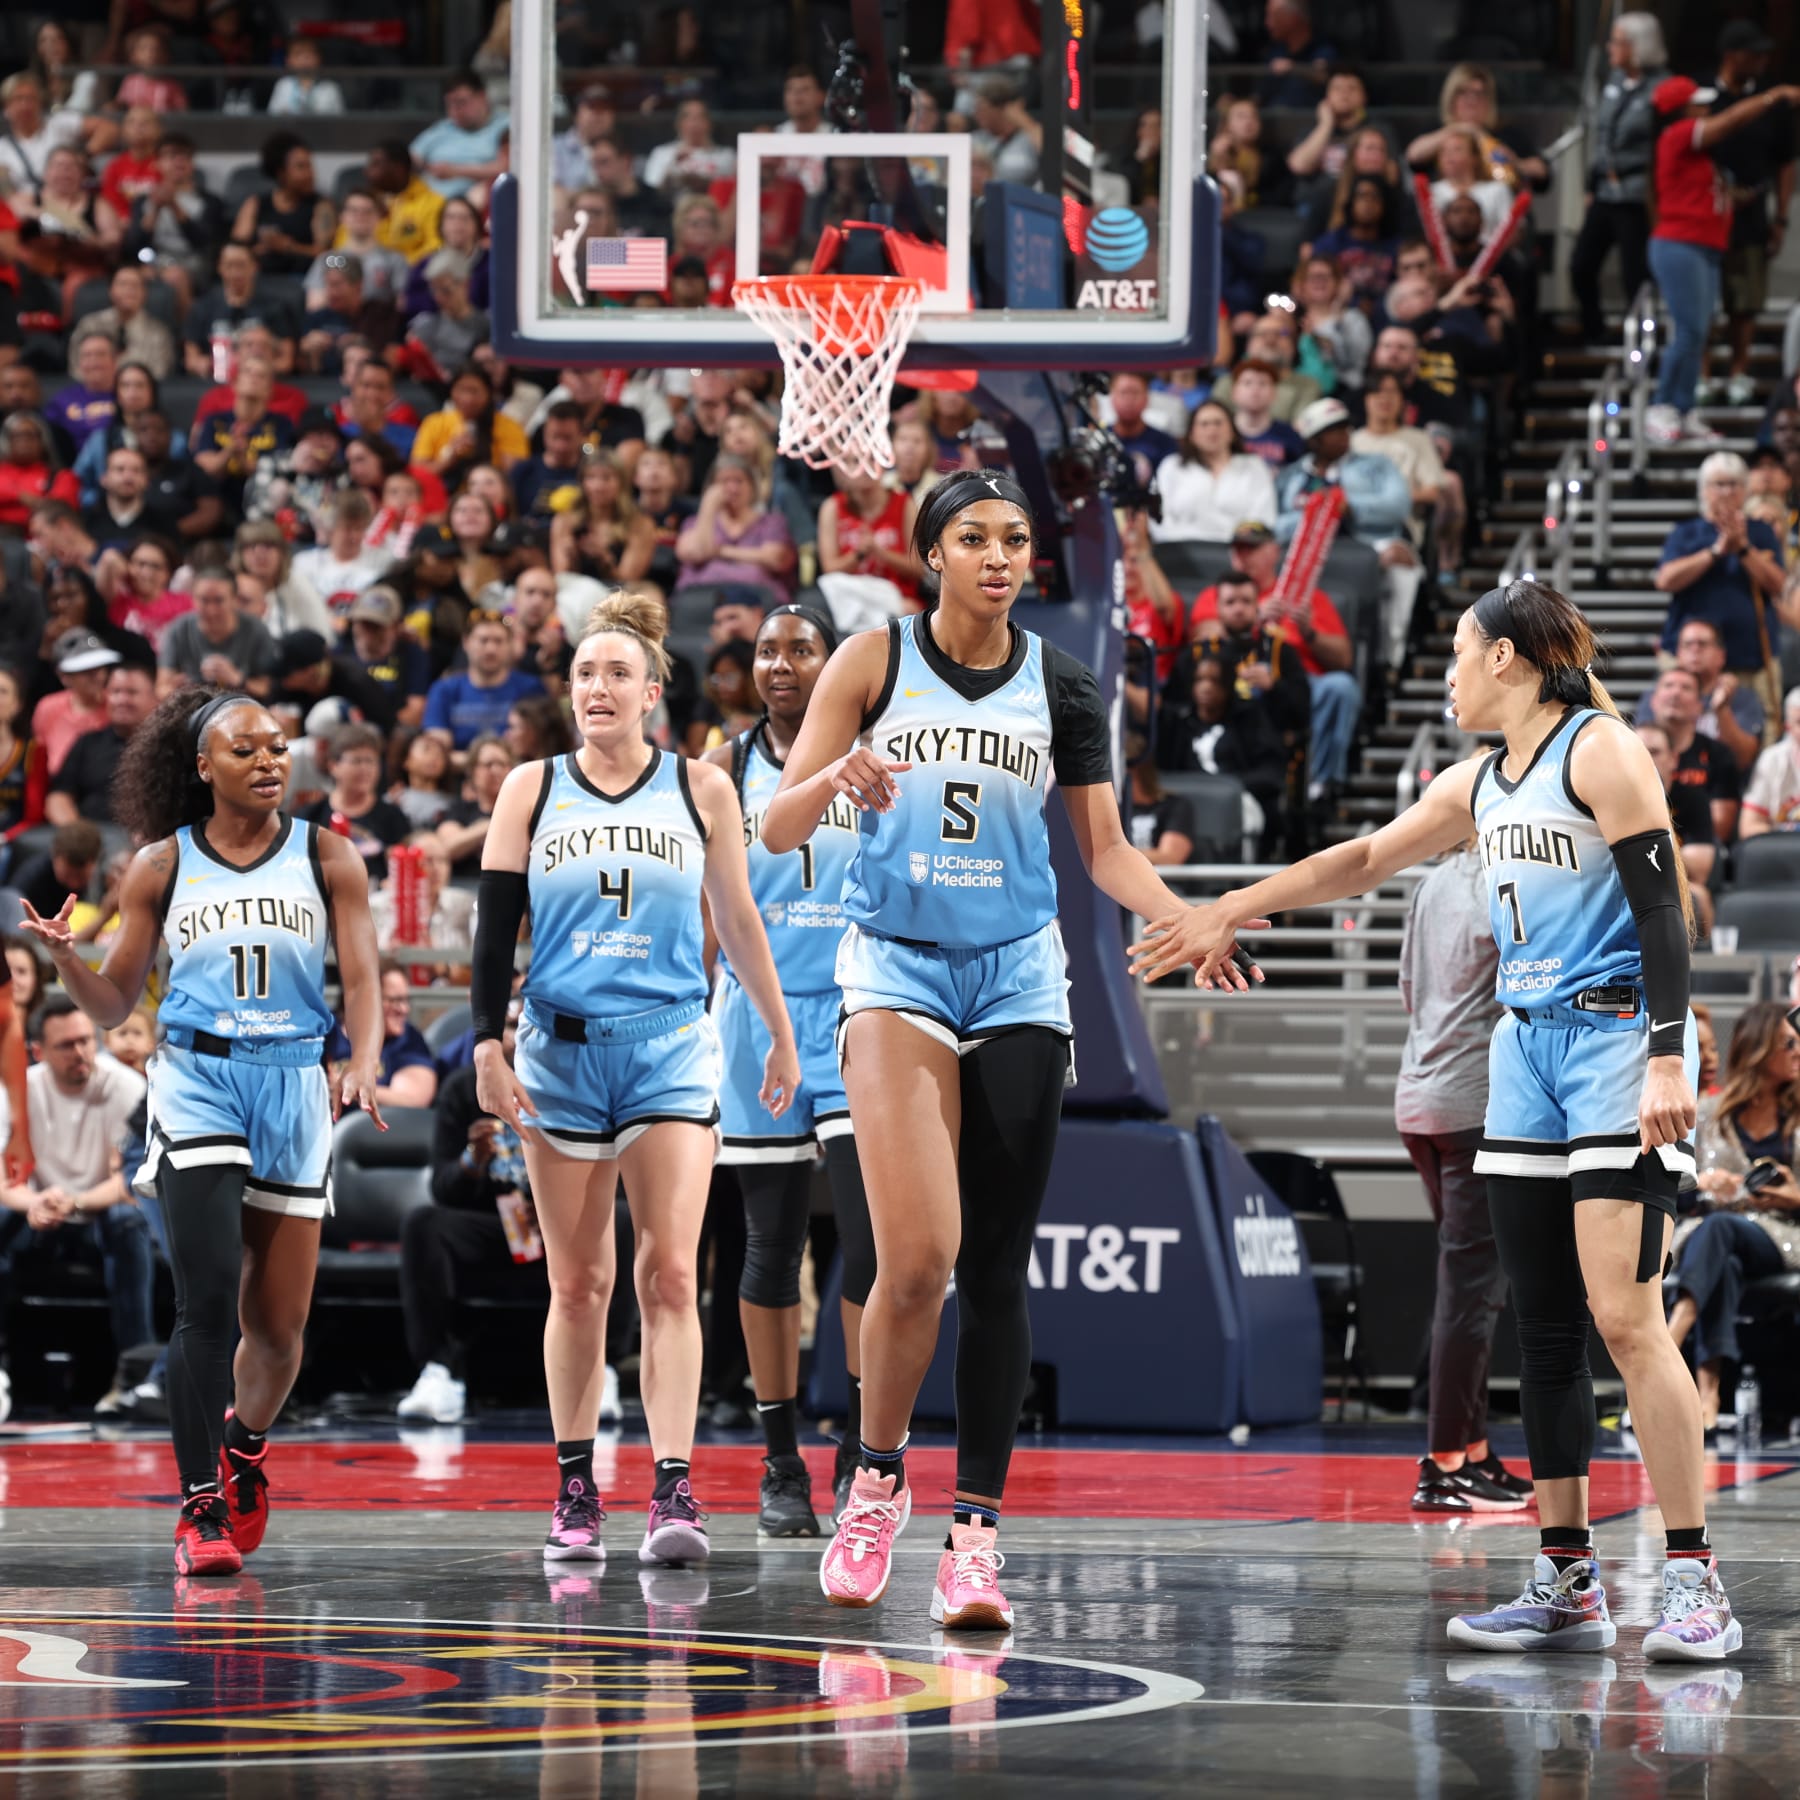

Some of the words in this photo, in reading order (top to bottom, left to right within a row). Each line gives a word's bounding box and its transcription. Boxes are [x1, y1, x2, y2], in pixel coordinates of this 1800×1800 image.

[1076, 279, 1156, 309] AT&T
[940, 779, 982, 844] 5
[796, 841, 815, 892] 1
[932, 854, 1004, 872] UChicago
[932, 872, 1003, 888] Medicine
[597, 866, 633, 920] 4
[786, 901, 842, 914] UChicag
[1497, 880, 1528, 944] 7
[787, 914, 847, 928] Medicine
[591, 930, 652, 945] UChicago
[591, 945, 649, 960] Medicine
[228, 944, 271, 1000] 11
[1500, 957, 1562, 976] UChicago
[233, 1009, 292, 1024] UChicago
